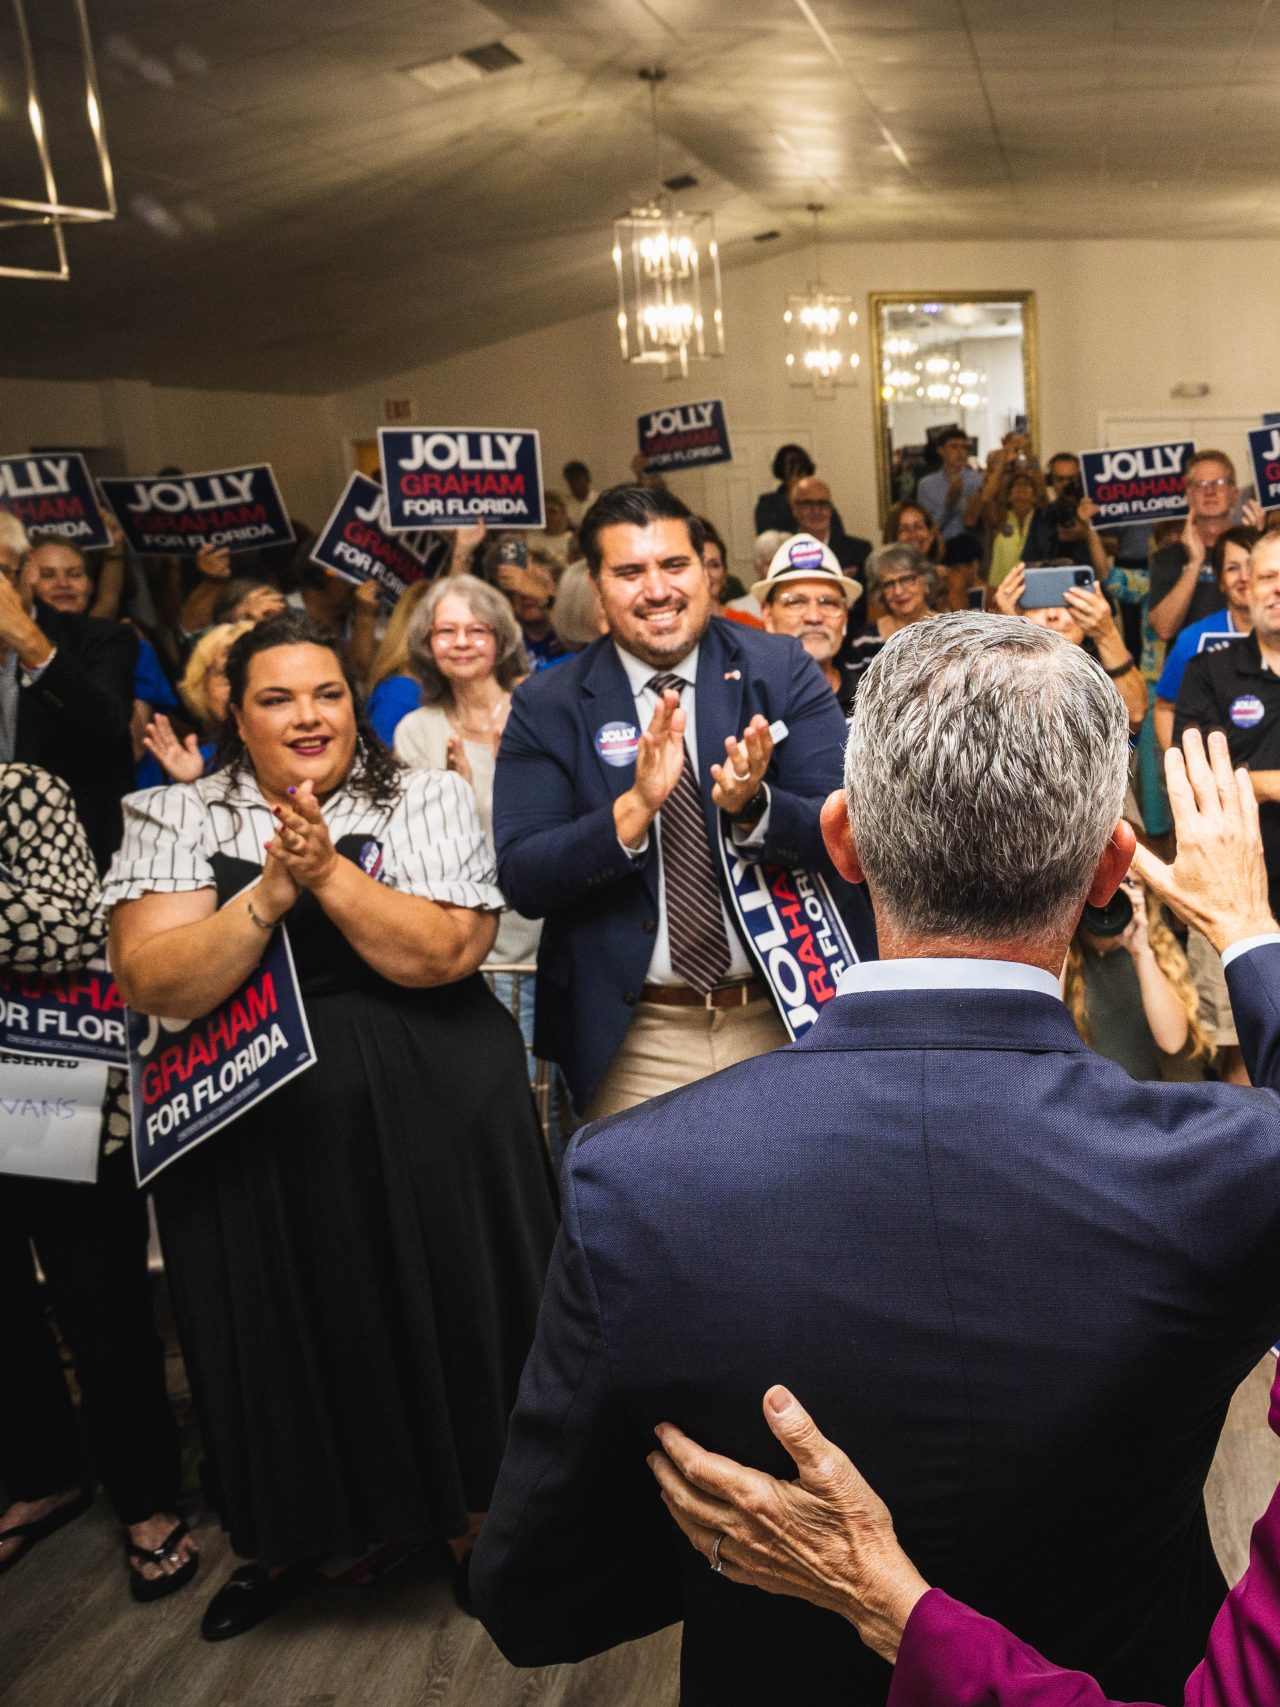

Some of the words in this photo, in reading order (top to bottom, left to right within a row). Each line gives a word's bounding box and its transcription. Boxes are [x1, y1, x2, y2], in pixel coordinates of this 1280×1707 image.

[645, 404, 713, 438] JOLLY
[398, 433, 522, 470] JOLLY
[1095, 446, 1184, 483] JOLLY
[126, 472, 255, 513] JOLLY
[400, 473, 525, 496] GRAHAM
[1096, 475, 1187, 502] GRAHAM
[402, 499, 444, 517] FOR
[447, 498, 528, 516] FLORIDA
[1100, 503, 1129, 516] FOR
[333, 540, 373, 572] FOR
[599, 727, 636, 743] JOLLY
[791, 868, 838, 957] FLORI
[37, 1007, 126, 1045] FLOR
[140, 971, 278, 1104] GRAHAM
[0, 1054, 79, 1069] ESERVED
[146, 1092, 190, 1146] FOR
[192, 1022, 289, 1112] FLORIDA
